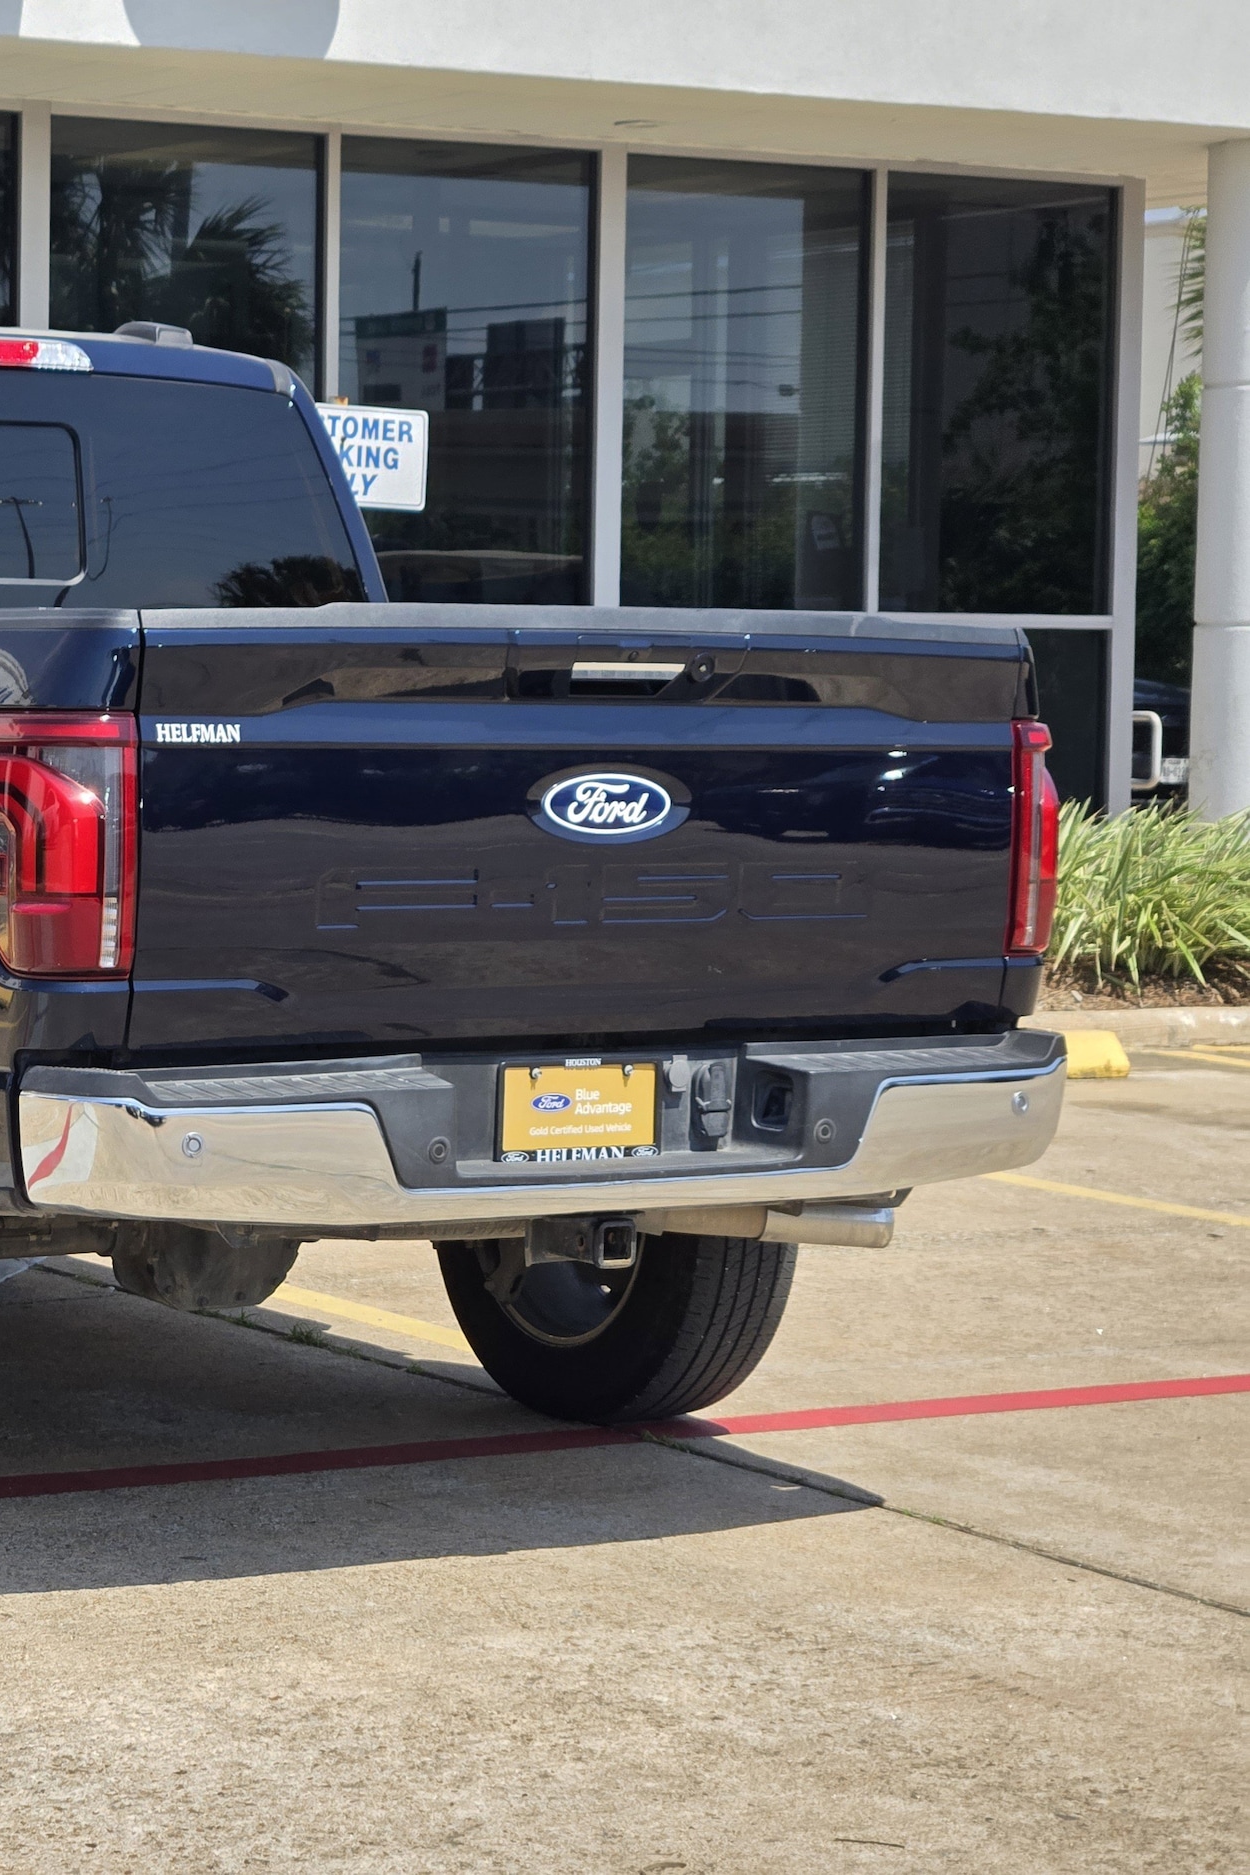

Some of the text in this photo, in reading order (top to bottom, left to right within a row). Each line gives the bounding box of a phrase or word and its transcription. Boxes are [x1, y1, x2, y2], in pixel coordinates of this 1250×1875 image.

[321, 413, 414, 443] TOMER
[155, 723, 241, 743] HELFMAN
[567, 781, 650, 824] Ford
[565, 1058, 602, 1067] HOUSTON
[575, 1088, 600, 1100] Blue
[538, 1095, 565, 1109] Ford
[575, 1102, 632, 1115] Advantage
[529, 1122, 632, 1136] Gold Certified Used Vehicle
[504, 1152, 525, 1163] Ford
[636, 1147, 655, 1158] Ford
